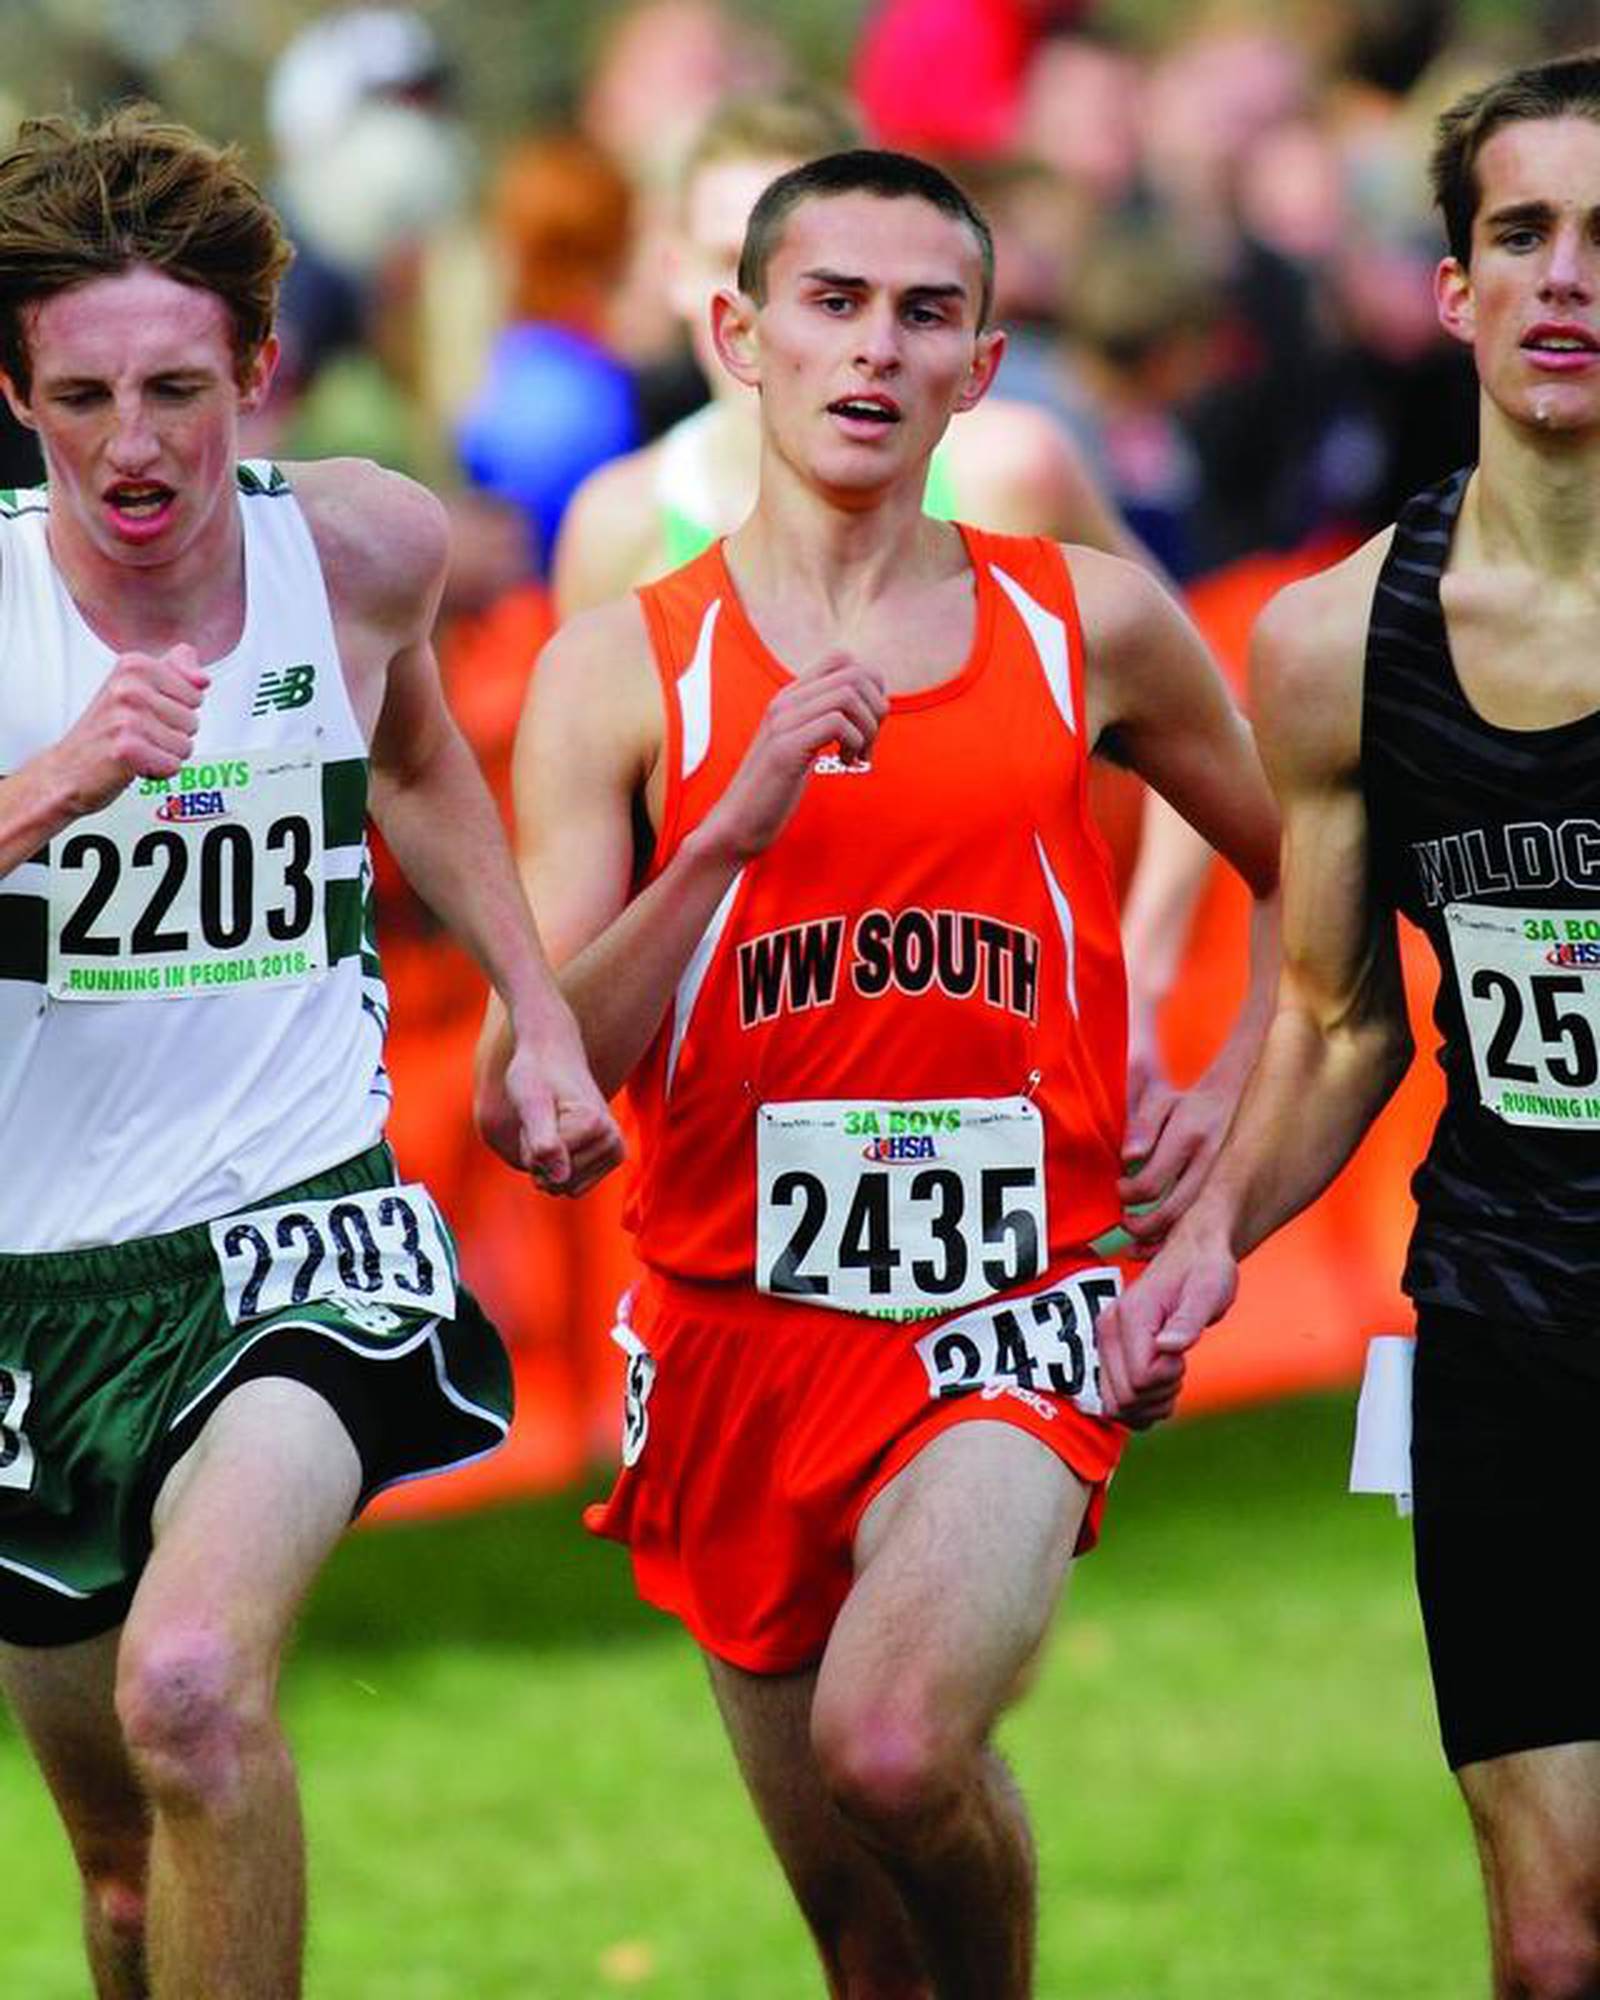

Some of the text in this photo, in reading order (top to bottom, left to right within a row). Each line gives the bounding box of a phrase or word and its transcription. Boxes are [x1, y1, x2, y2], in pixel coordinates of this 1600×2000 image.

[180, 761, 248, 790] BOYS
[60, 816, 313, 956] 2203
[737, 907, 1040, 1030] WW SOUTH
[1524, 919, 1558, 941] 3A
[69, 953, 305, 990] RUNNING IN PEORIA 2018
[1472, 969, 1598, 1088] 25
[844, 1111, 880, 1134] 3A
[888, 1109, 961, 1132] BOYS
[1502, 1091, 1581, 1118] RUNNING
[224, 1197, 434, 1316] 2203
[770, 1168, 1040, 1296] 2435
